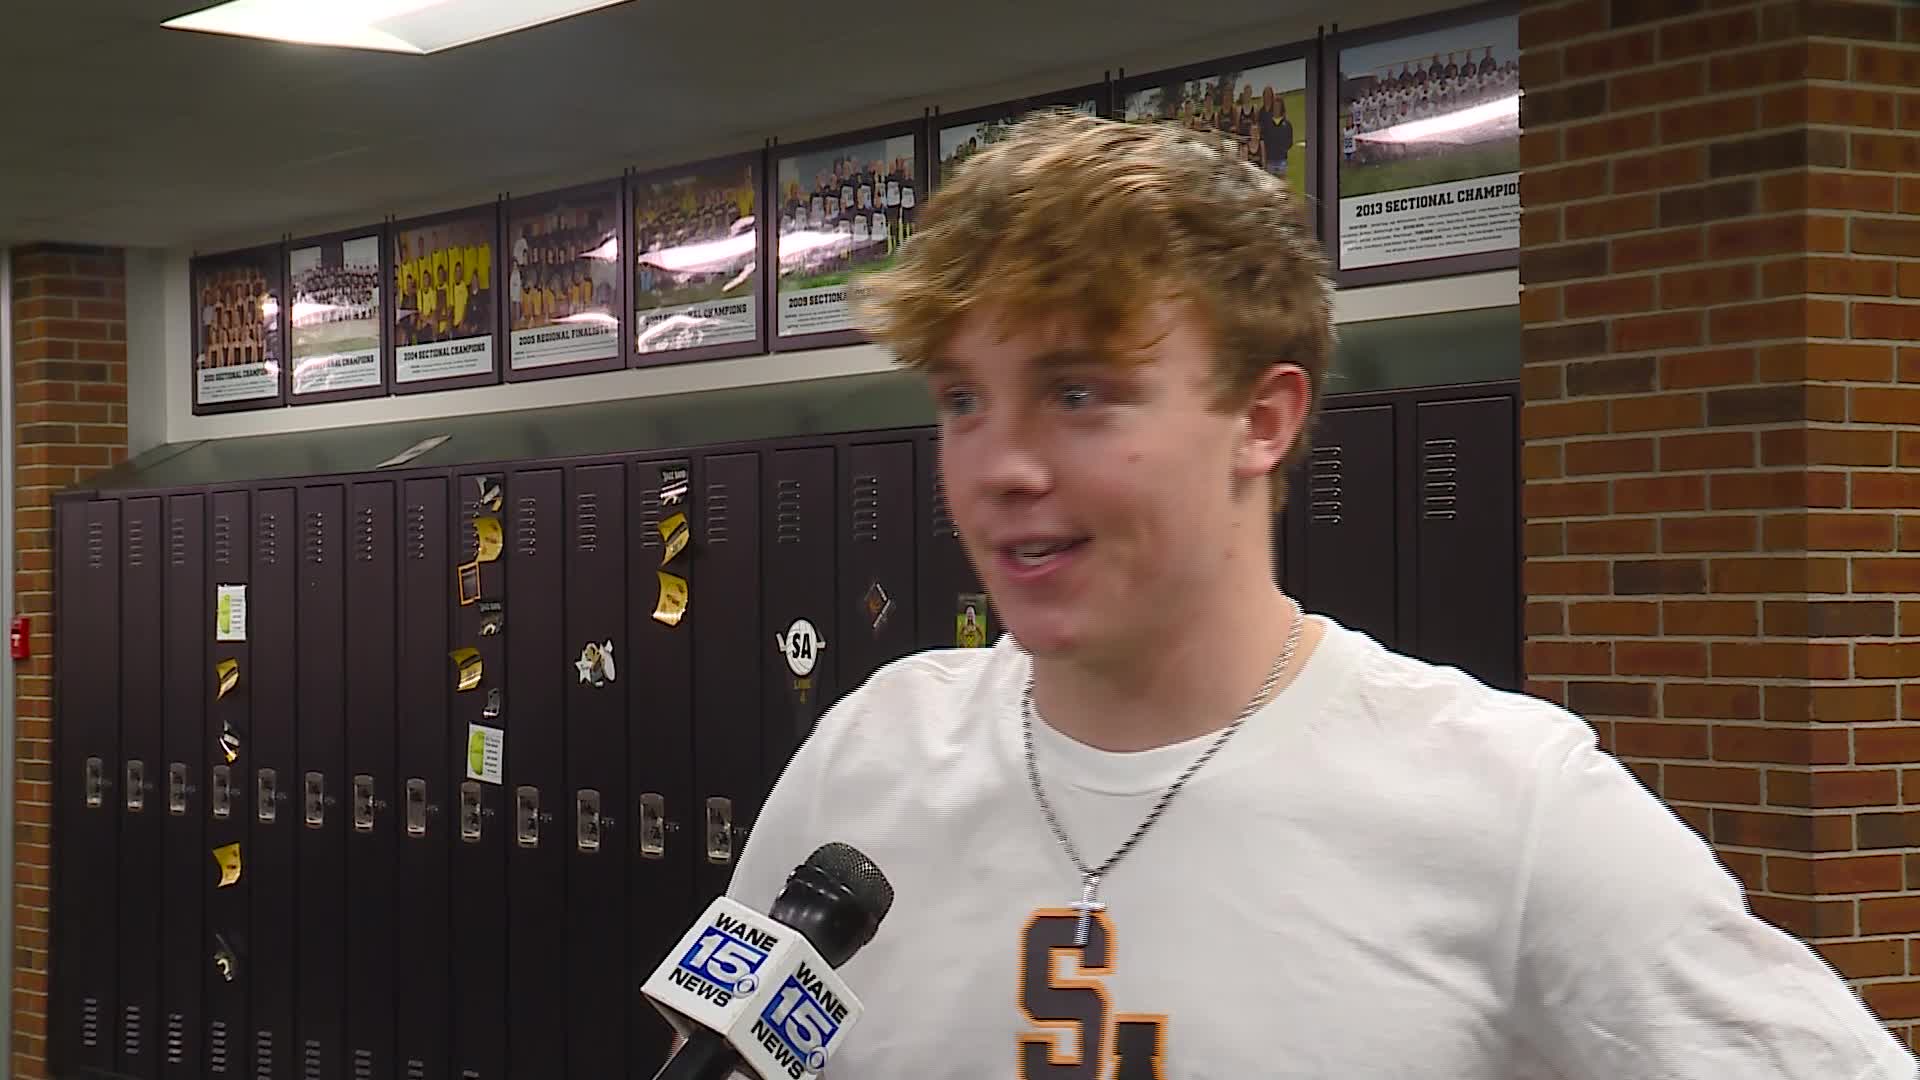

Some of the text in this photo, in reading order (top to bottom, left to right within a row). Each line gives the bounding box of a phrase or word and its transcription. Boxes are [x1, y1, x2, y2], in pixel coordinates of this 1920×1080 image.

[1356, 182, 1520, 218] 2013 SECTIONAL CHAMPIO
[703, 303, 747, 318] CHAMPIONS
[418, 346, 450, 360] SECTIONAL
[451, 342, 485, 355] CHAMPIONS
[536, 329, 570, 344] REGIONAL
[792, 632, 812, 659] SA
[715, 912, 778, 952] WANE
[684, 929, 768, 988] 15
[668, 967, 732, 1008] NEWS
[796, 961, 848, 1024] WANE
[766, 983, 836, 1053] 15
[750, 1019, 805, 1080] NEWS
